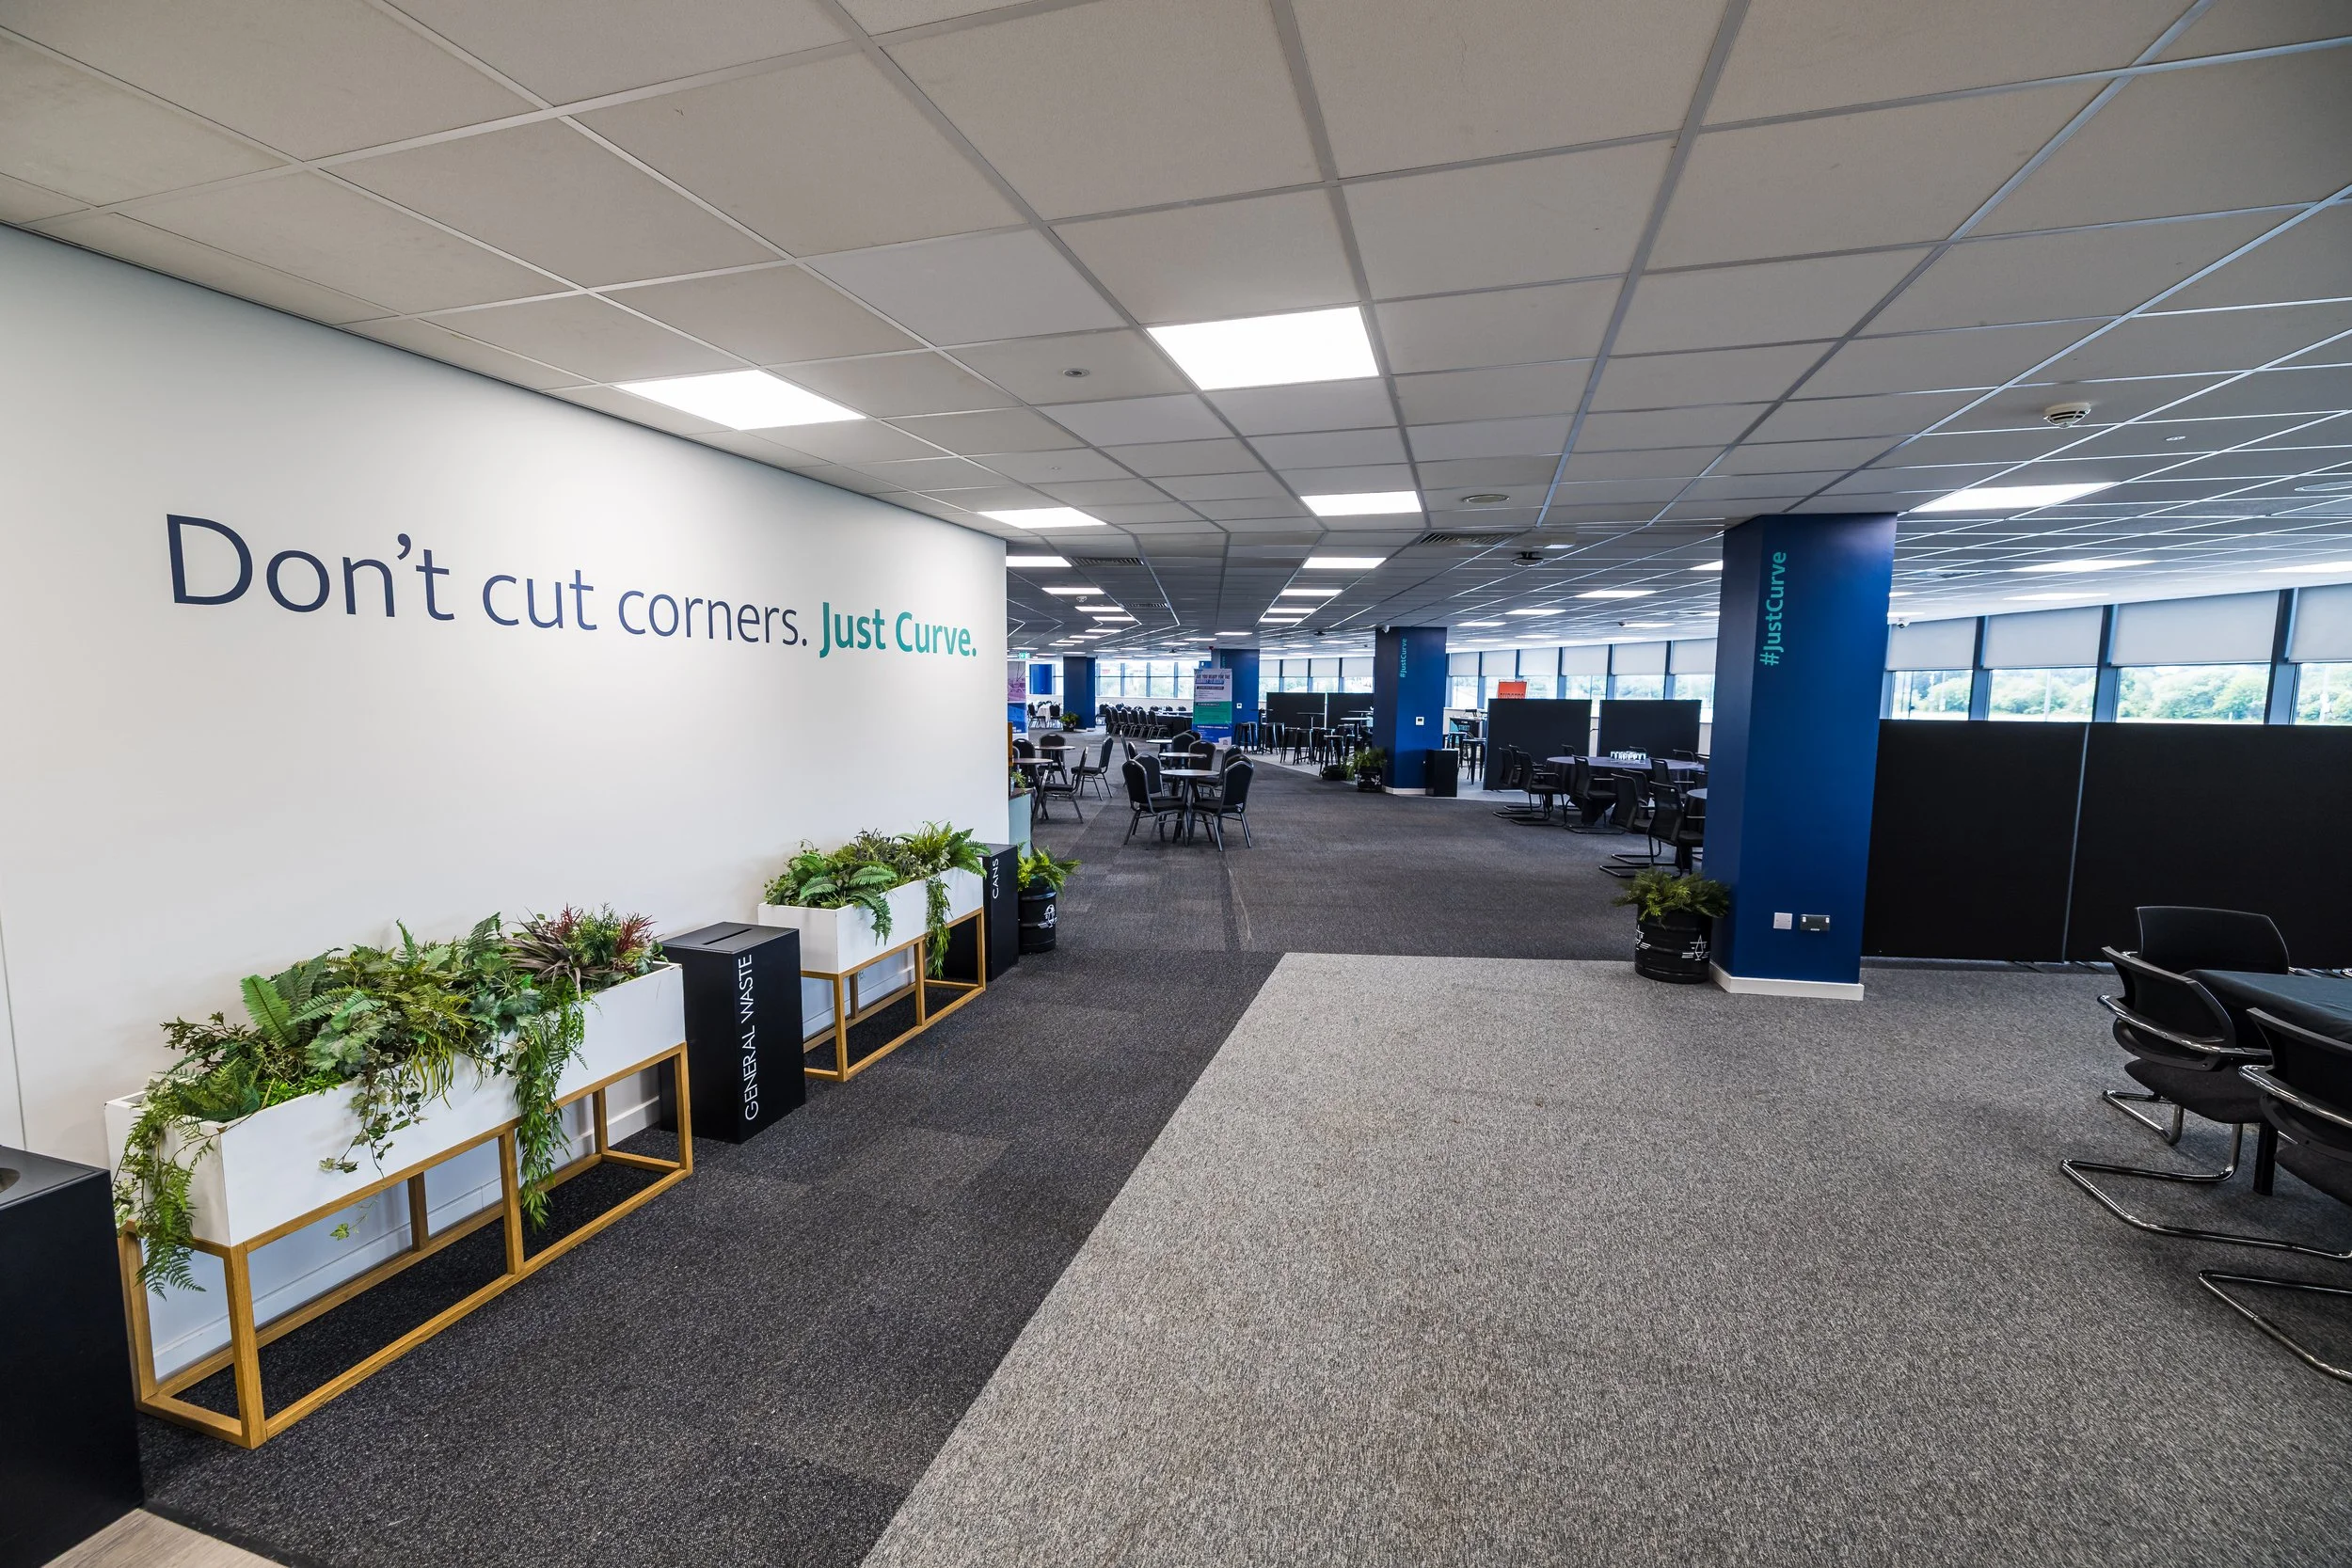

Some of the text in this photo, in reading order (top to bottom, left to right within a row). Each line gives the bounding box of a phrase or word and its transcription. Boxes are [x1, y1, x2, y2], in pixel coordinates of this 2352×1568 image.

[167, 513, 977, 659] Don’t cut corners. Just Curve.
[1759, 551, 1787, 666] #JustCurve
[1399, 638, 1407, 678] #JustCurve
[738, 954, 759, 1121] GENERAL WASTE
